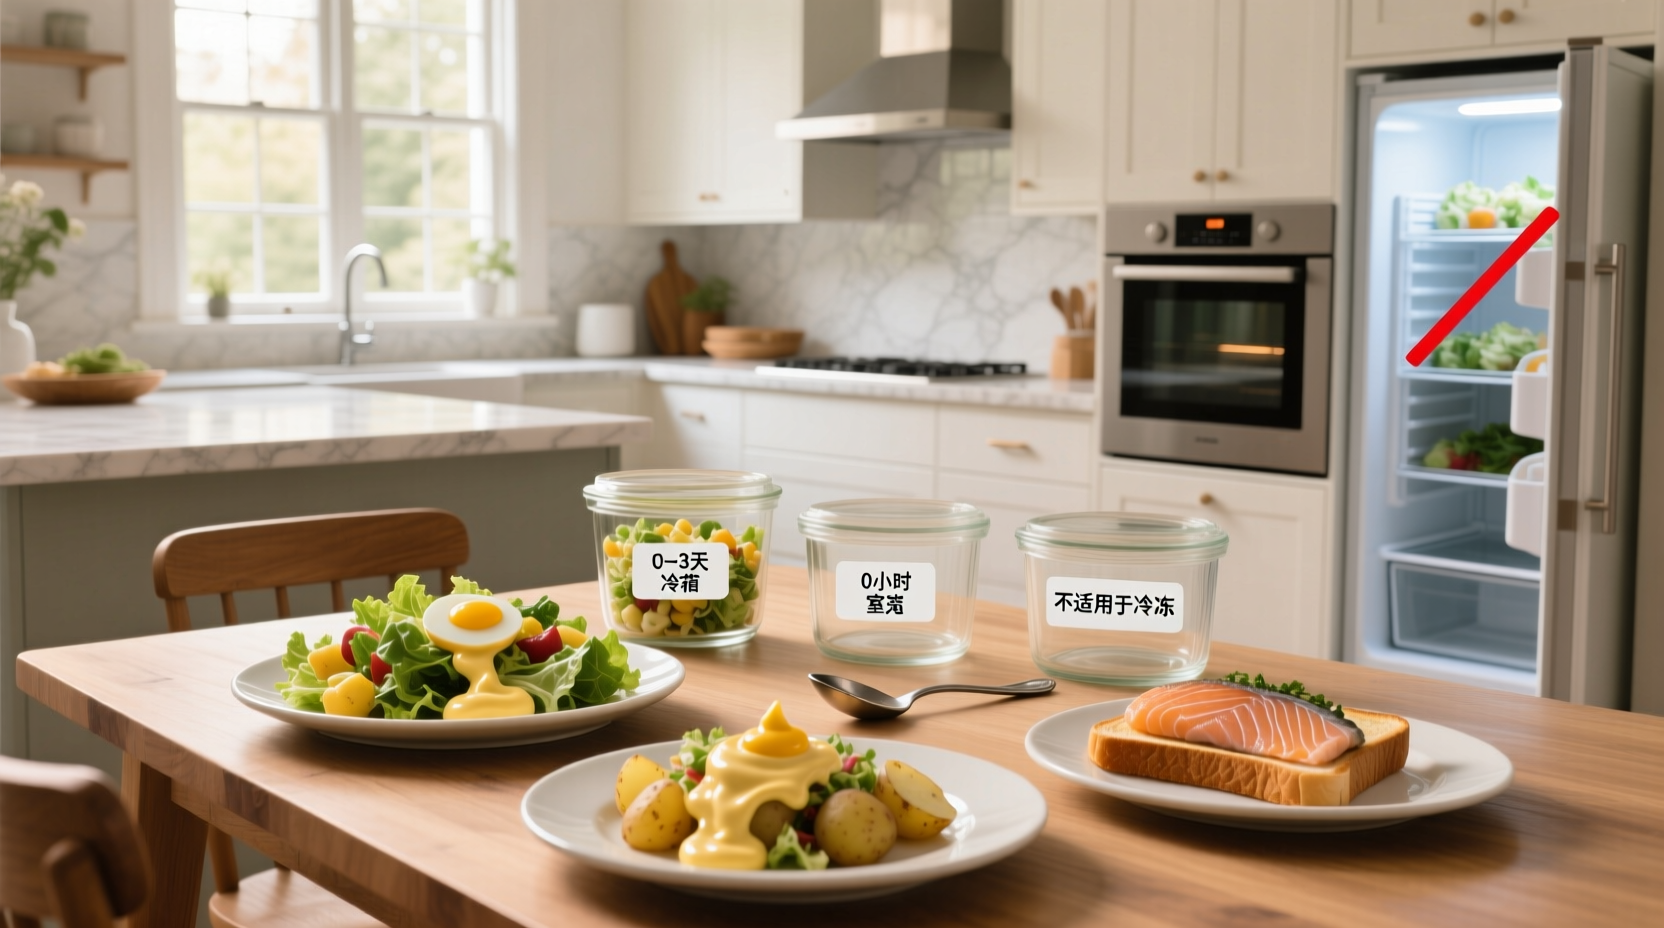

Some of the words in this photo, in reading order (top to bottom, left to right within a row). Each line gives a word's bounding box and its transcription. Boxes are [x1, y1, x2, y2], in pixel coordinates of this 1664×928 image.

[861, 571, 912, 591] 0小时
[1054, 591, 1175, 617] 不适用于冷冻
